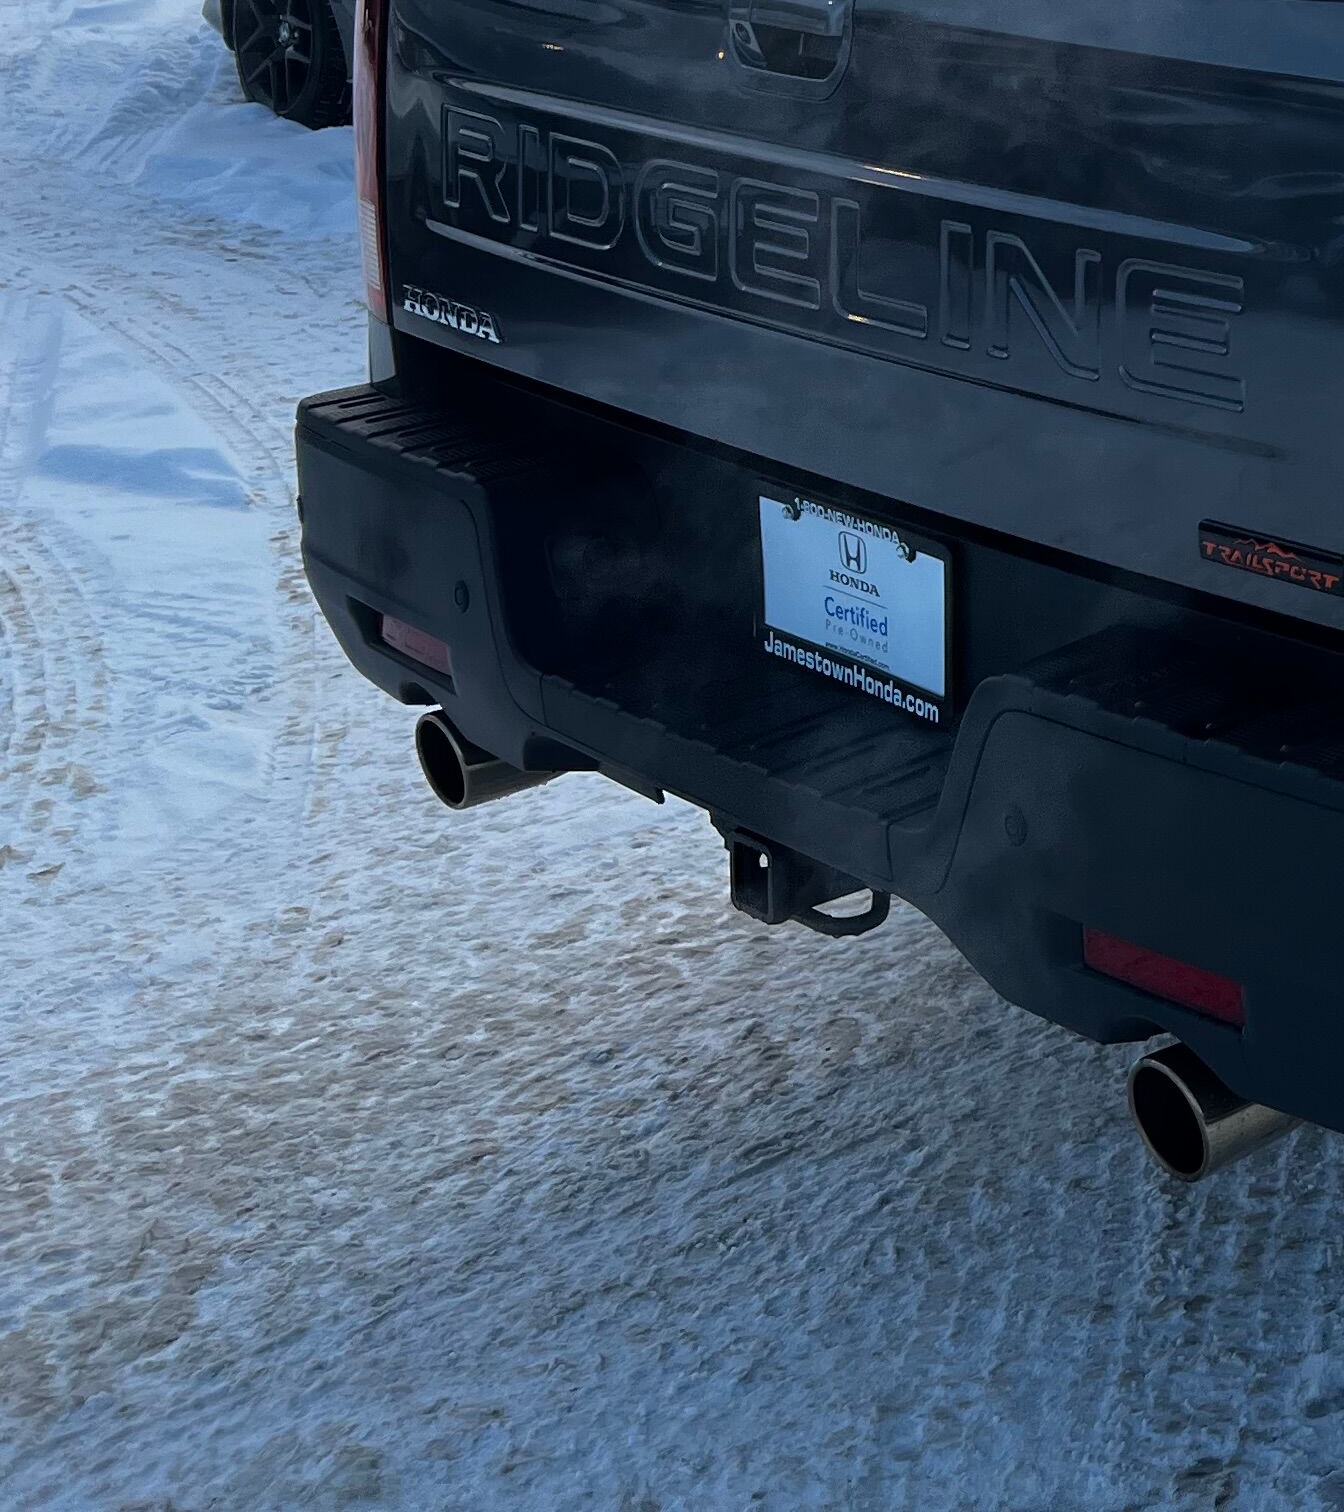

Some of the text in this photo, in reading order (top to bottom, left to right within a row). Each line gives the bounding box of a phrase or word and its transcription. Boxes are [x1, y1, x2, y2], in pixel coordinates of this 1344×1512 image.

[442, 103, 1245, 413] RIDGELINE
[402, 284, 501, 344] HONDA
[795, 497, 900, 546] 1-800-NEW-HONDA
[830, 569, 880, 597] HONDA
[1202, 540, 1340, 590] TRAILSPORT
[824, 596, 888, 637] Certified
[764, 631, 939, 723] JamestownHonda.com
